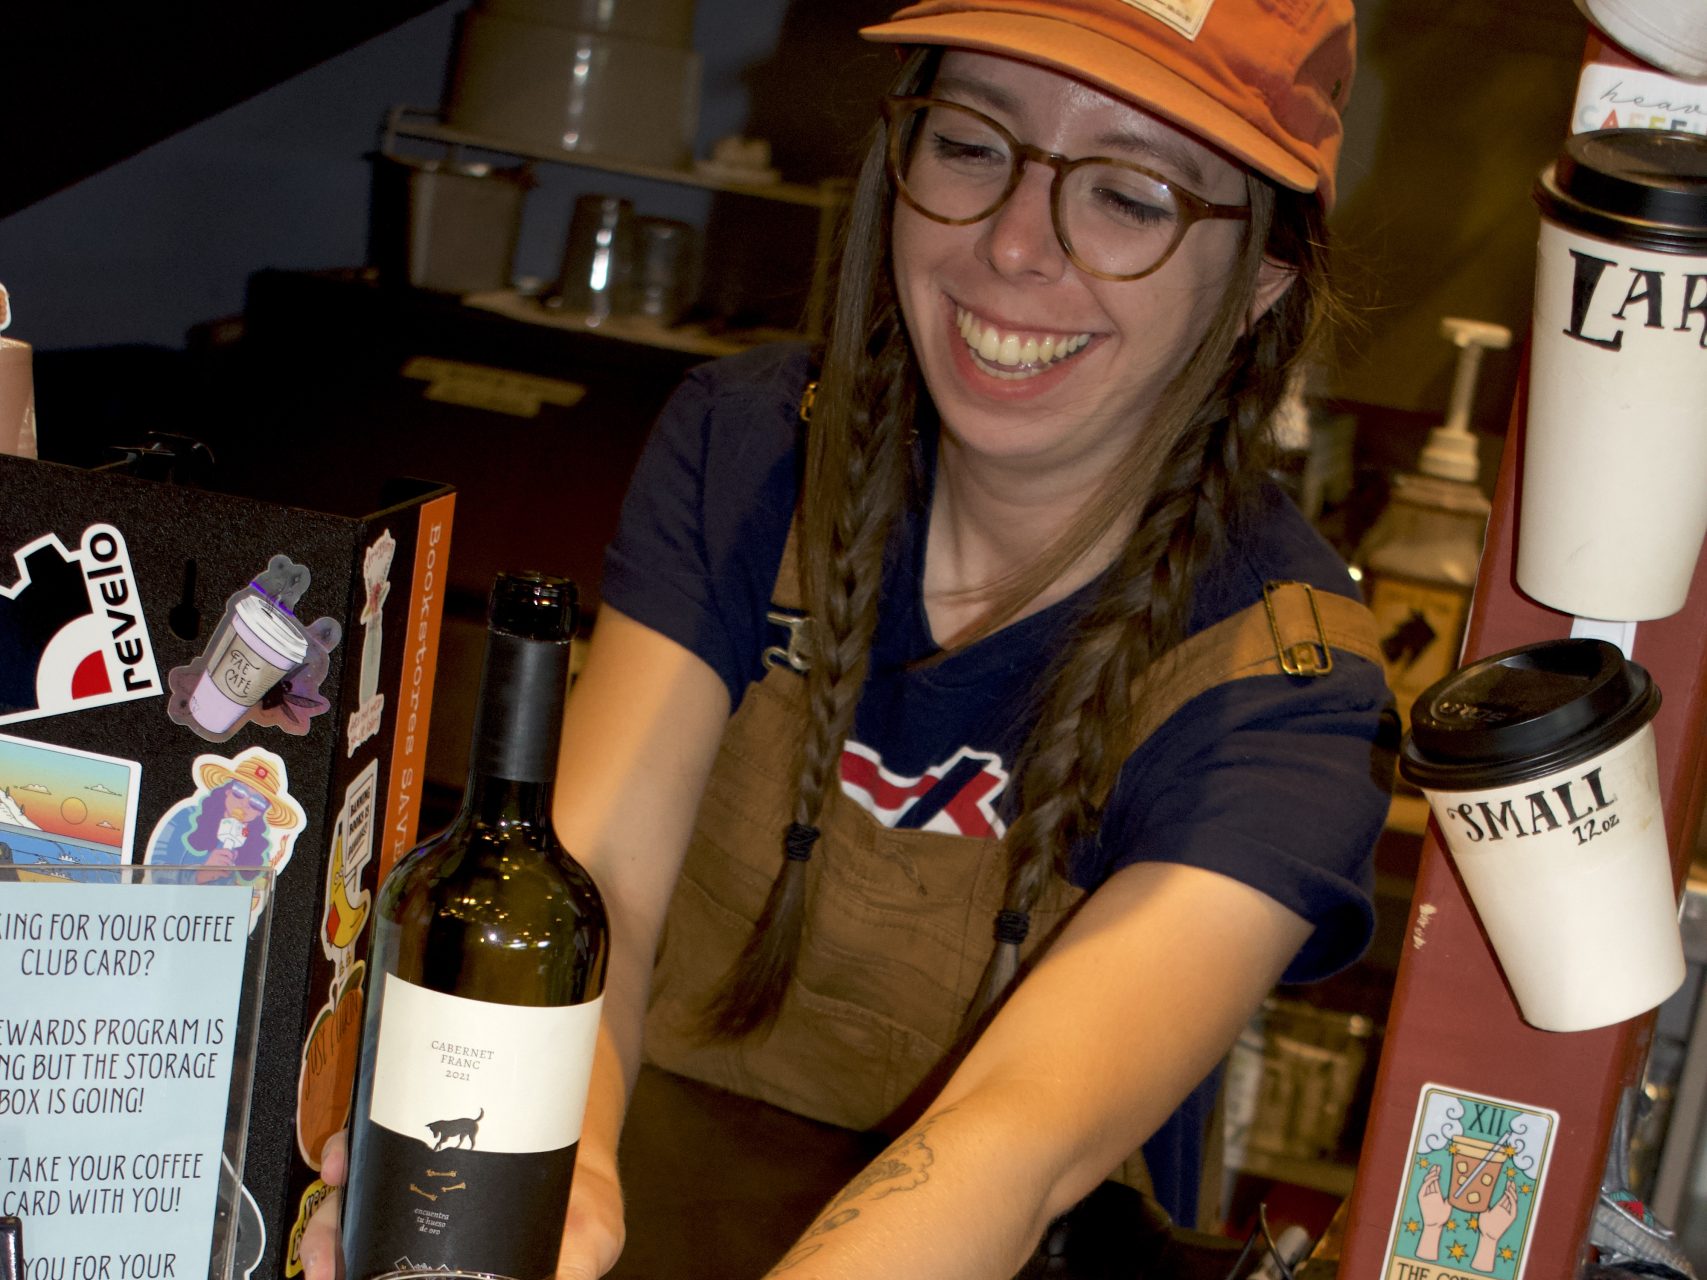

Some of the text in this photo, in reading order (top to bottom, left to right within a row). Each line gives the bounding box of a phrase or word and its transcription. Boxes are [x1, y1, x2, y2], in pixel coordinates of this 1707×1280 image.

[1563, 248, 1707, 352] LAR
[405, 523, 442, 755] Bookstores
[1447, 766, 1617, 842] SMALL
[0, 914, 235, 942] ING FOR YOUR COFFEE
[21, 948, 155, 976] CLUB CARD?
[94, 1019, 199, 1045] PROGRAM
[206, 1018, 224, 1045] IS
[431, 1040, 494, 1060] CABERNET
[441, 1054, 480, 1070] FRANC
[32, 1054, 76, 1080] BUT
[83, 1053, 120, 1080] THE
[124, 1052, 218, 1079] STORAGE
[445, 1070, 470, 1081] 2021
[0, 1087, 145, 1115] BOX IS GOING!
[1468, 1104, 1506, 1137] XII
[8, 1153, 204, 1183] TAKE YOUR COFFEE
[3, 1187, 181, 1217] CARD WITH YOU!
[414, 1208, 449, 1221] encuentra
[118, 1253, 177, 1280] YOUR
